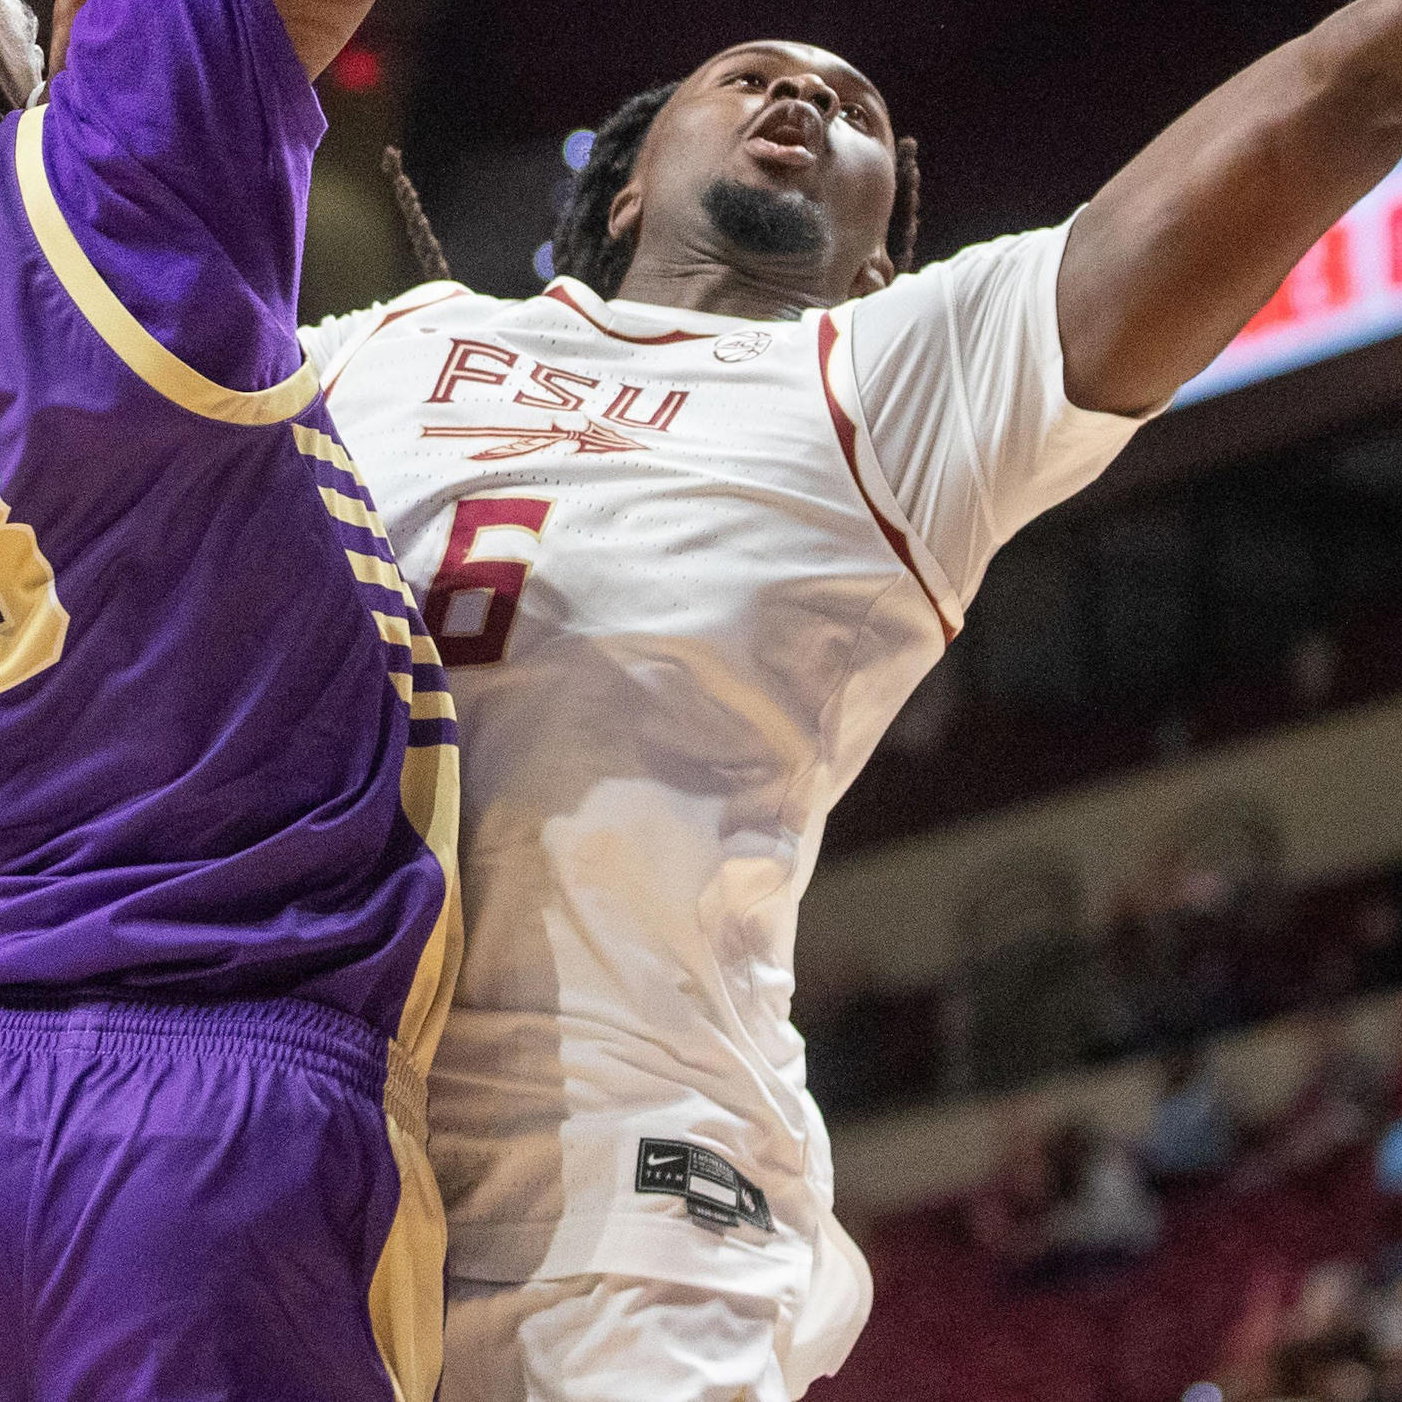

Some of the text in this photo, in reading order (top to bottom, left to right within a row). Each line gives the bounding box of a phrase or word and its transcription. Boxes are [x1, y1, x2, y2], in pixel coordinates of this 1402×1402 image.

[423, 338, 690, 432] FSU
[422, 496, 557, 668] 6
[646, 1169, 684, 1183] TEAM
